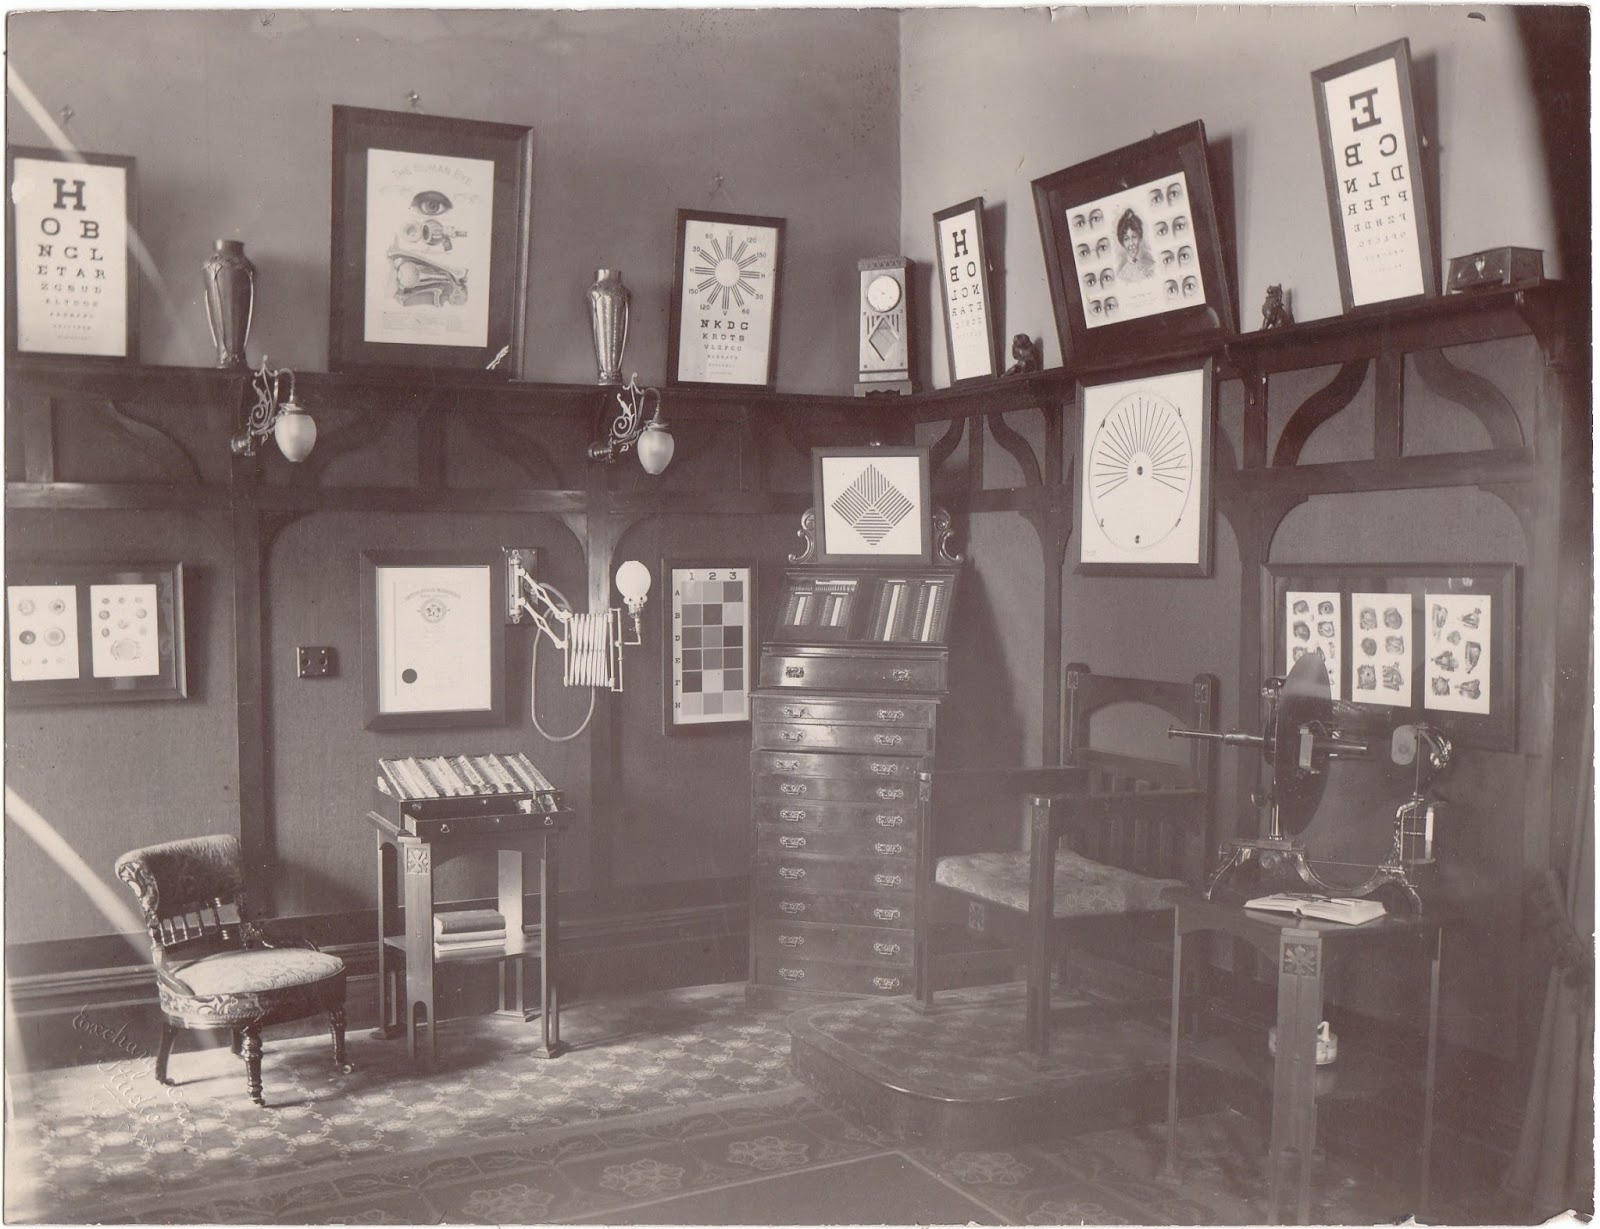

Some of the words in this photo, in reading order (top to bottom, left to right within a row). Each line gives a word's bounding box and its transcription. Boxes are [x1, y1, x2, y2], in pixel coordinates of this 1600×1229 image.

[53, 178, 86, 211] H
[41, 217, 61, 236] O
[80, 220, 100, 239] B
[689, 572, 695, 581] 1
[708, 572, 717, 581] 2
[729, 571, 737, 580] 3
